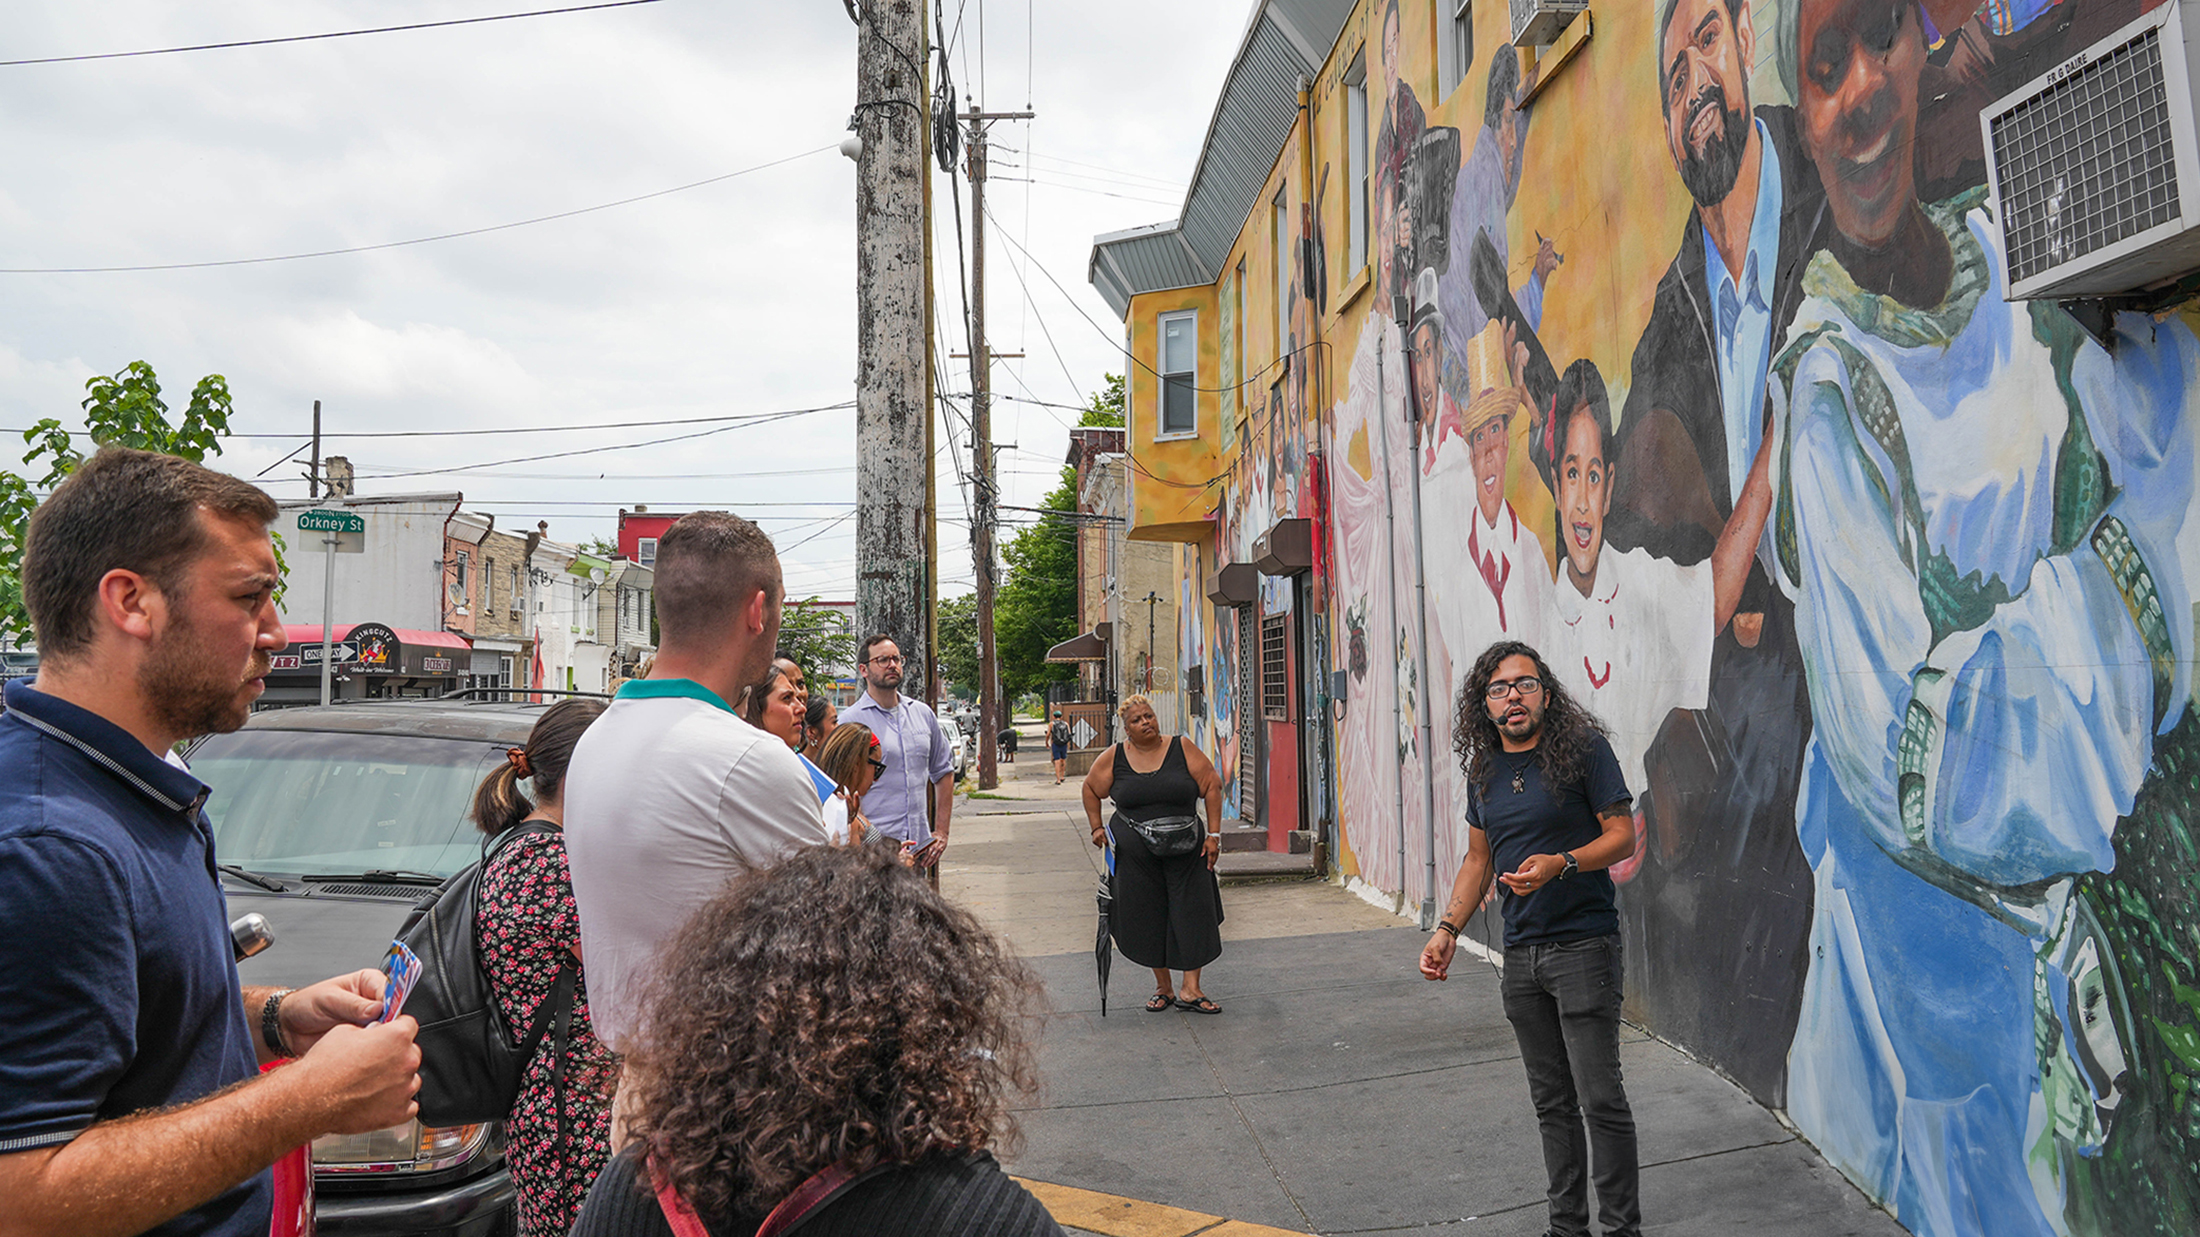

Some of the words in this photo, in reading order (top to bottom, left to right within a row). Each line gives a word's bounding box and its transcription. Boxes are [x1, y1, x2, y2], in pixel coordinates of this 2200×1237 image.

[300, 516, 346, 531] Orkney
[350, 519, 362, 531] St
[306, 649, 323, 659] ONE
